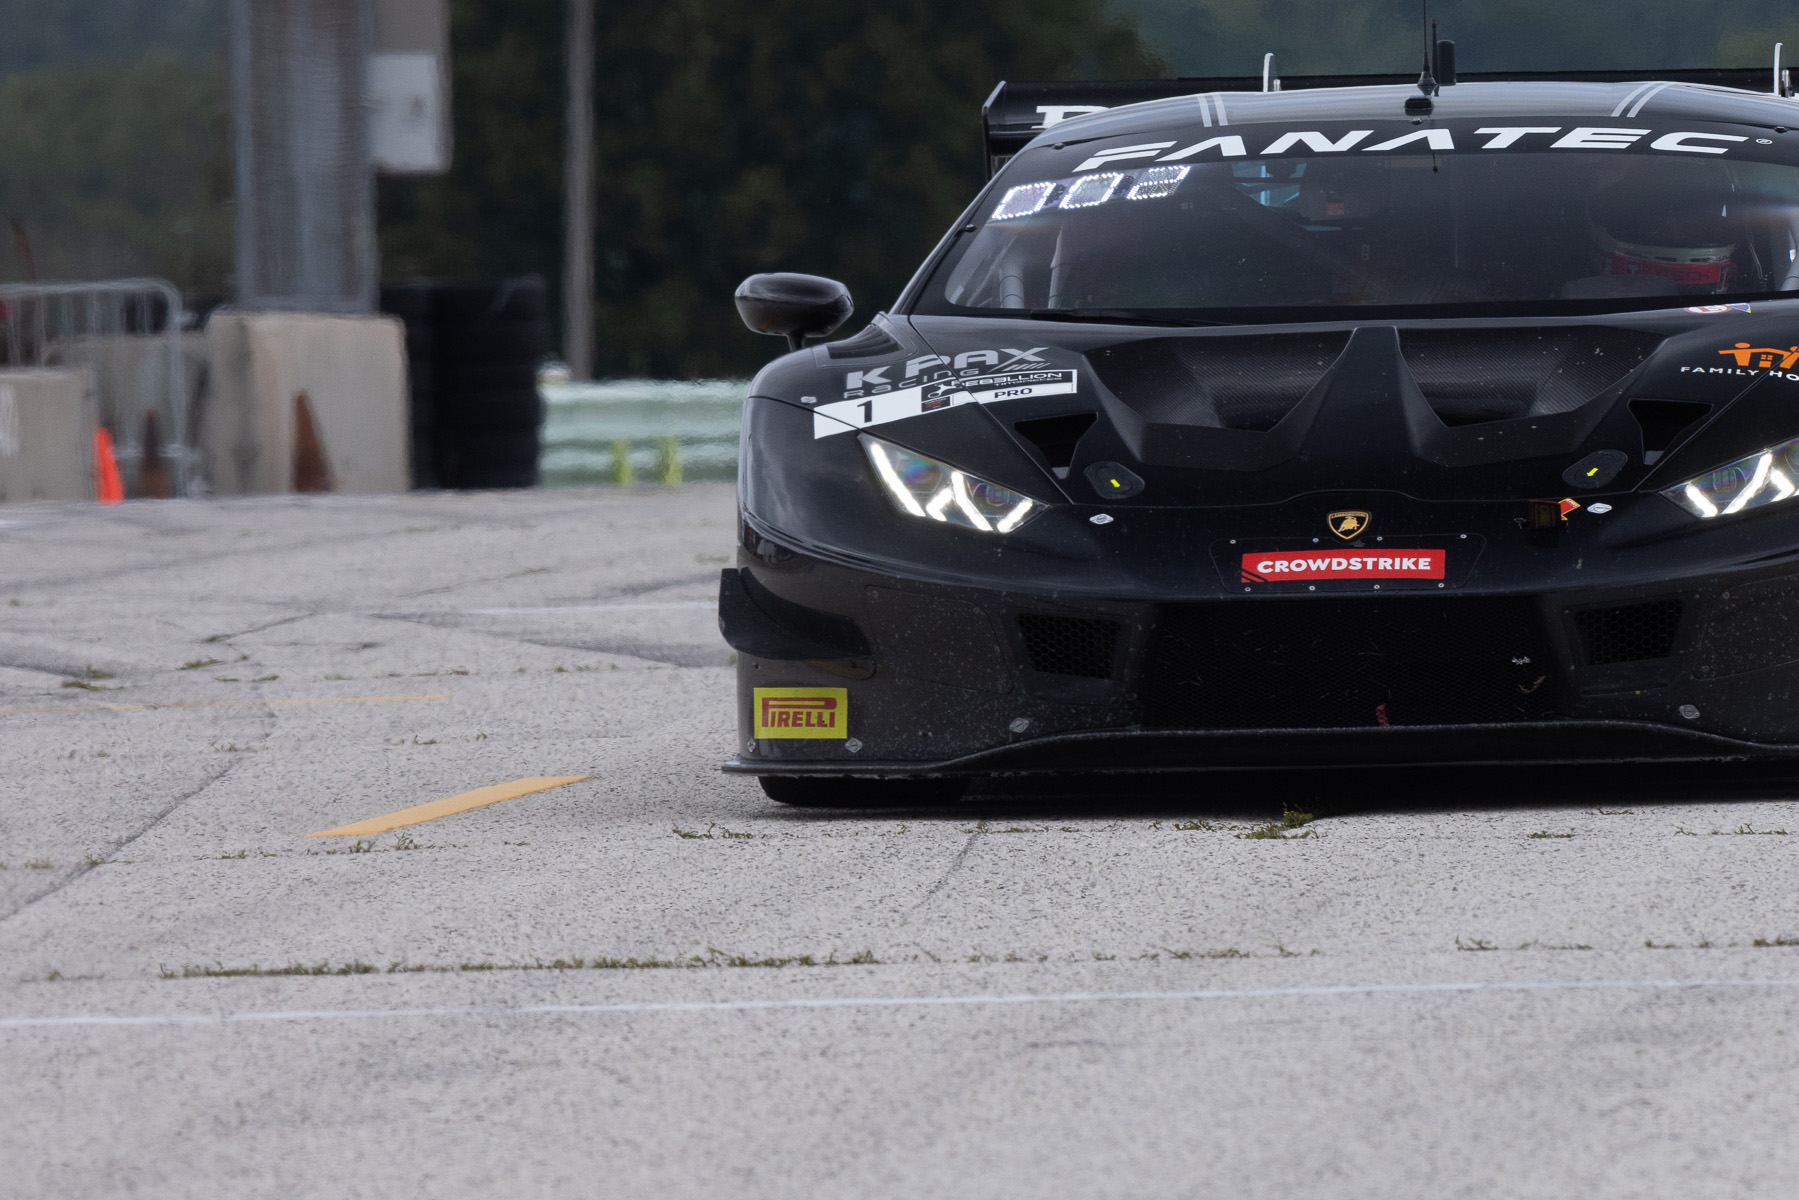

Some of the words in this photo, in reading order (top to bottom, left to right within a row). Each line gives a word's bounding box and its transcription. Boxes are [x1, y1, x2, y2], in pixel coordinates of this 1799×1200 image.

[1072, 126, 1750, 173] FANATEC
[991, 165, 1192, 221] 002
[845, 365, 892, 390] K
[905, 346, 1051, 378] PAX
[951, 371, 1062, 388] REBELLION
[1680, 366, 1760, 376] FAMILY
[994, 386, 1033, 399] PRO
[856, 400, 873, 424] 1
[1256, 557, 1432, 574] CROWDSTRIKE
[761, 697, 838, 728] PIRELLI
